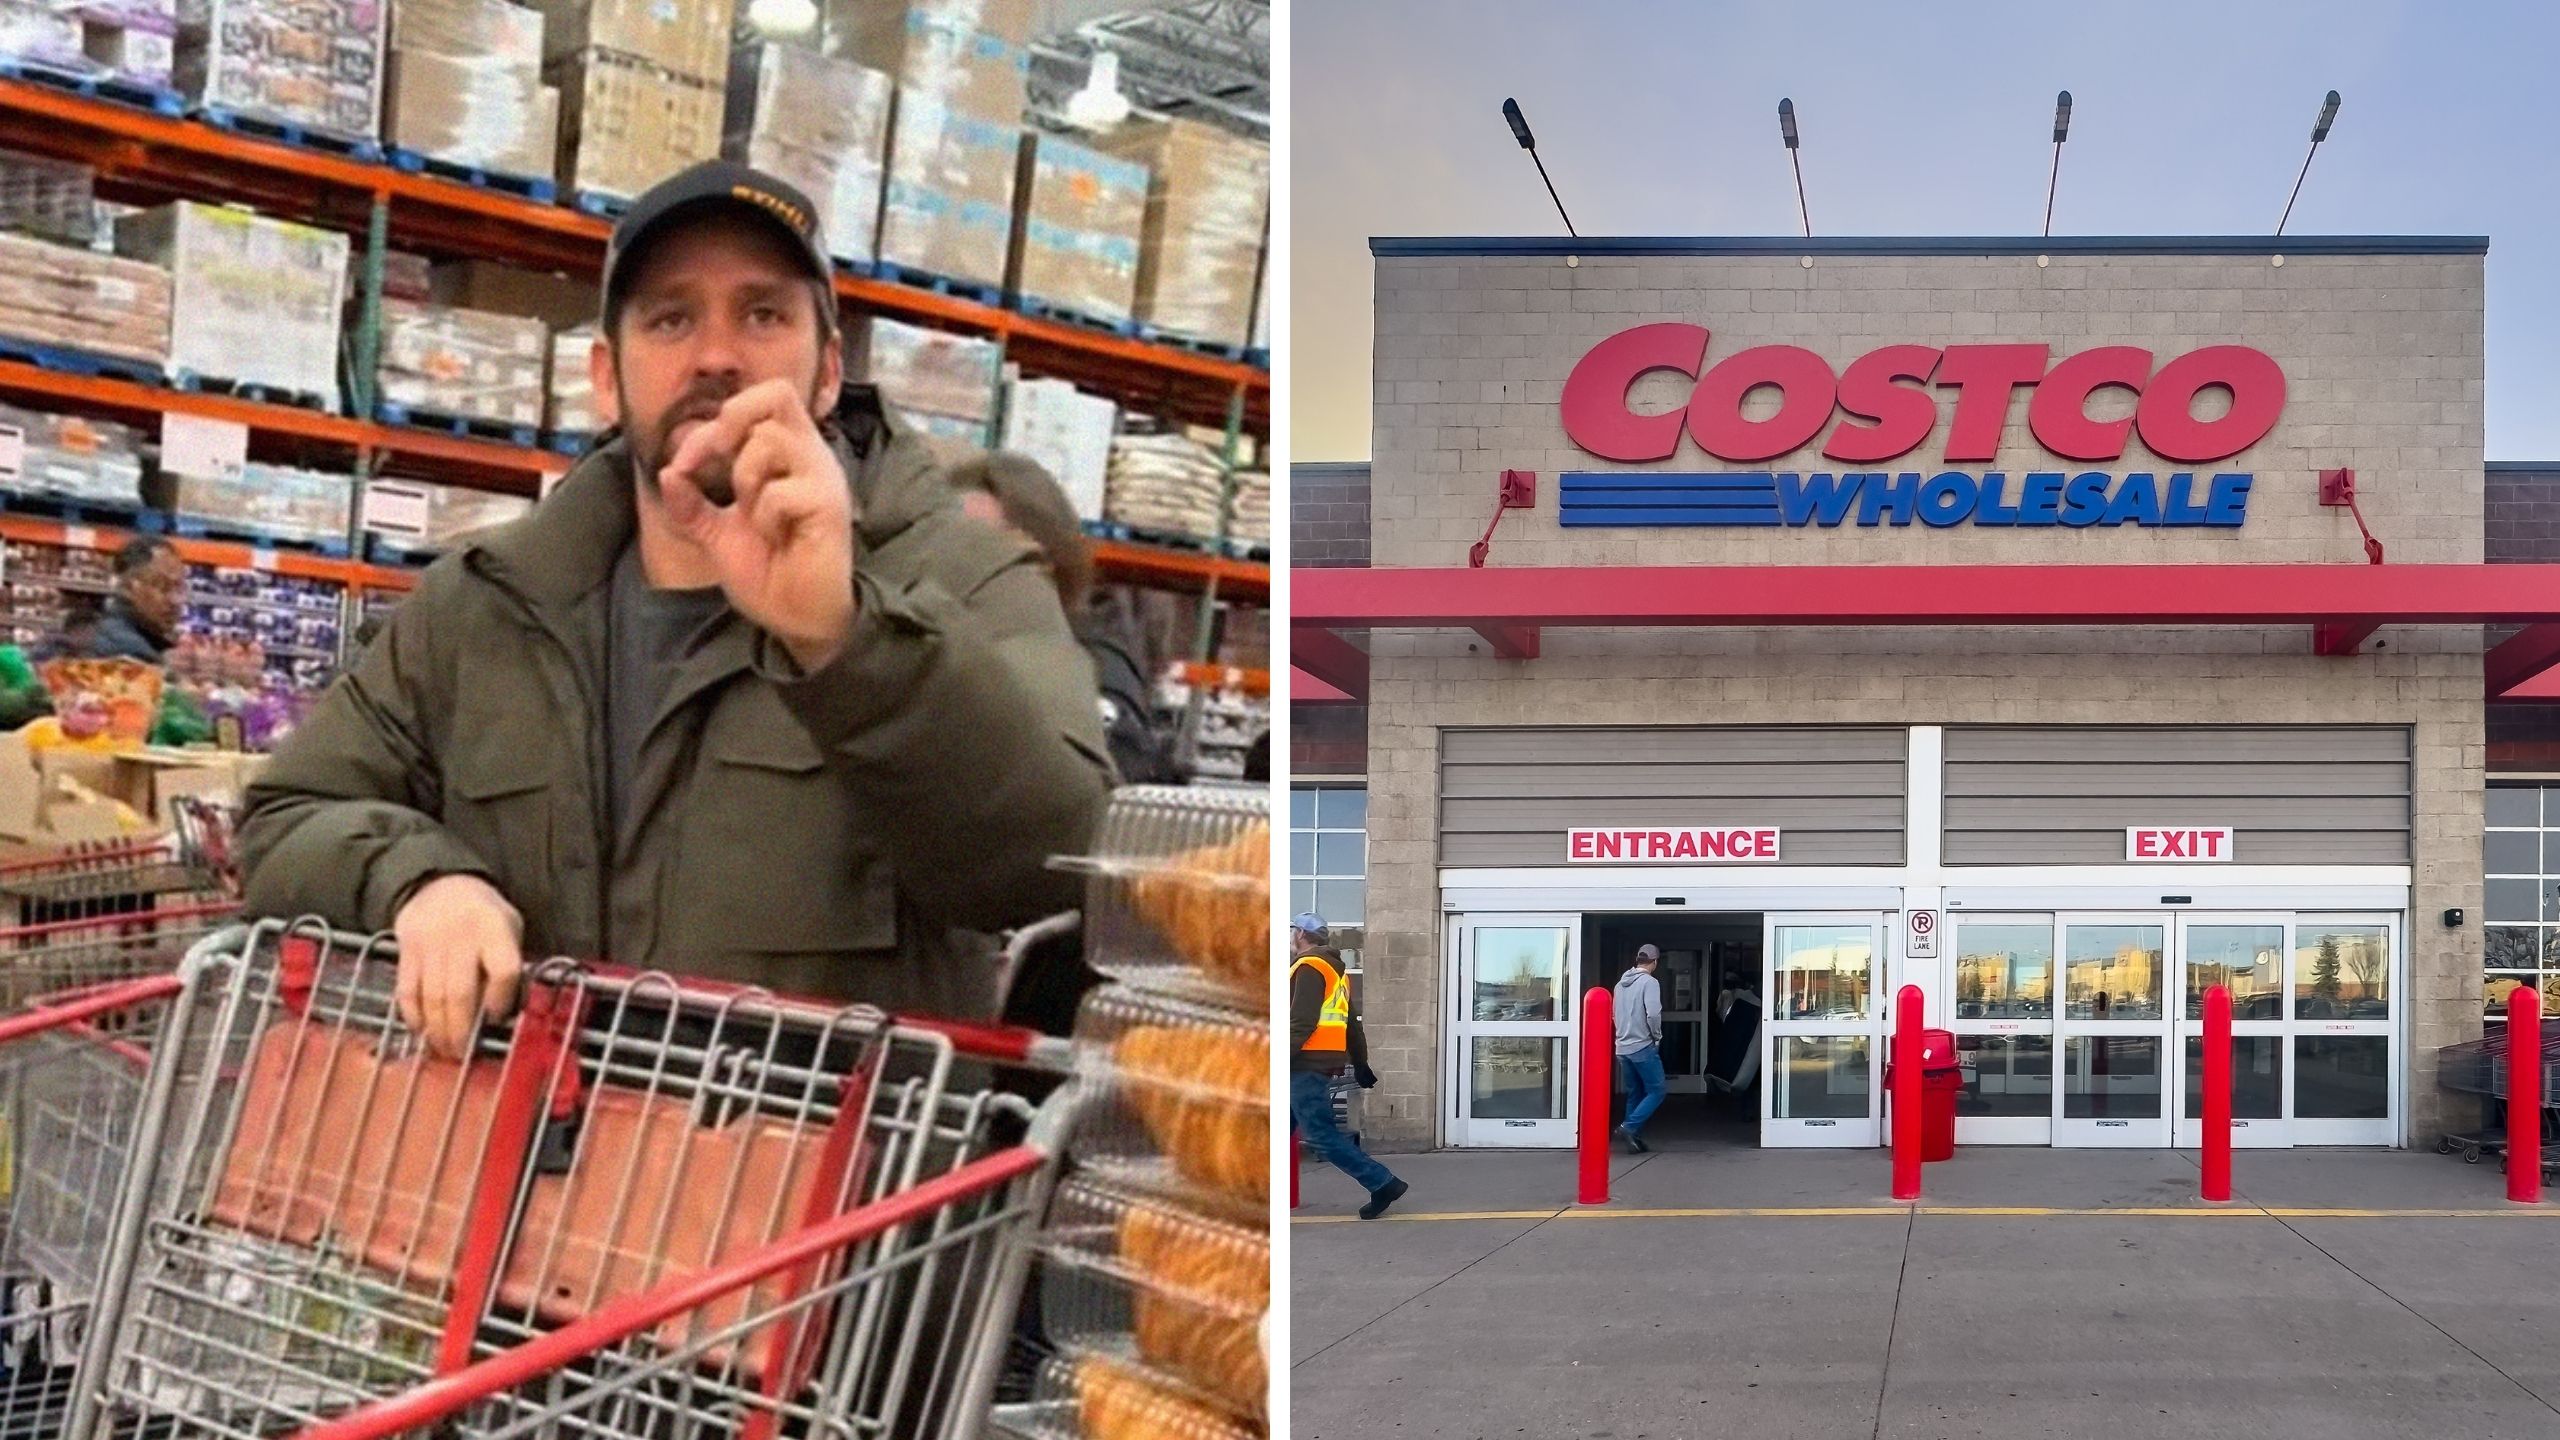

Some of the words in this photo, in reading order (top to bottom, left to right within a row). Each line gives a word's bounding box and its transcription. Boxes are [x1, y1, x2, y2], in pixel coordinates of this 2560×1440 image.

[1561, 322, 2286, 463] COSTCO
[1778, 472, 2253, 528] WHOLESALE
[1572, 831, 1776, 858] ENTRANCE
[2136, 831, 2225, 857] EXIT
